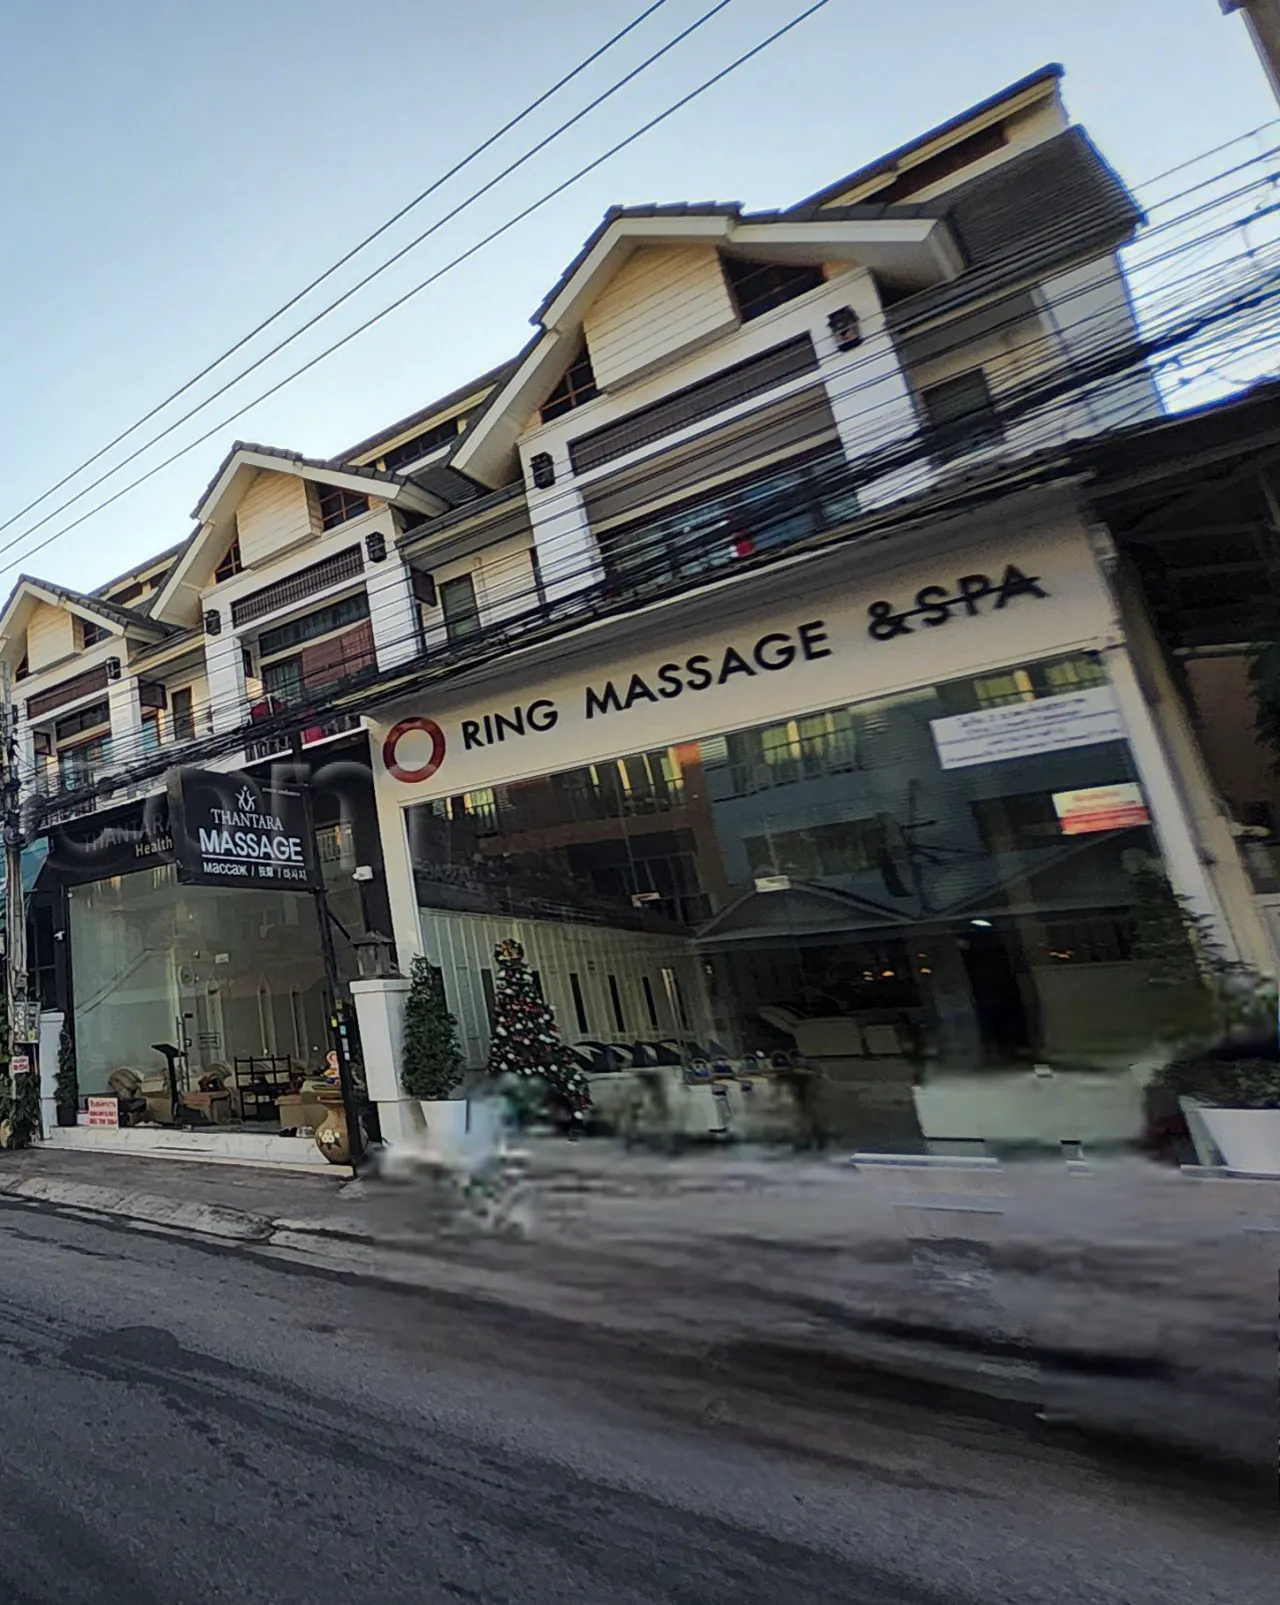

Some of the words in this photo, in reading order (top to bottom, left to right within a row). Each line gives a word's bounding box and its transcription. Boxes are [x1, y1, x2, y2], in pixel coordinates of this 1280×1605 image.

[461, 699, 558, 750] RING
[586, 620, 833, 719] MASSAGE
[210, 808, 284, 831] THANTARA
[135, 835, 173, 858] Health
[199, 827, 303, 861] MASSAGE
